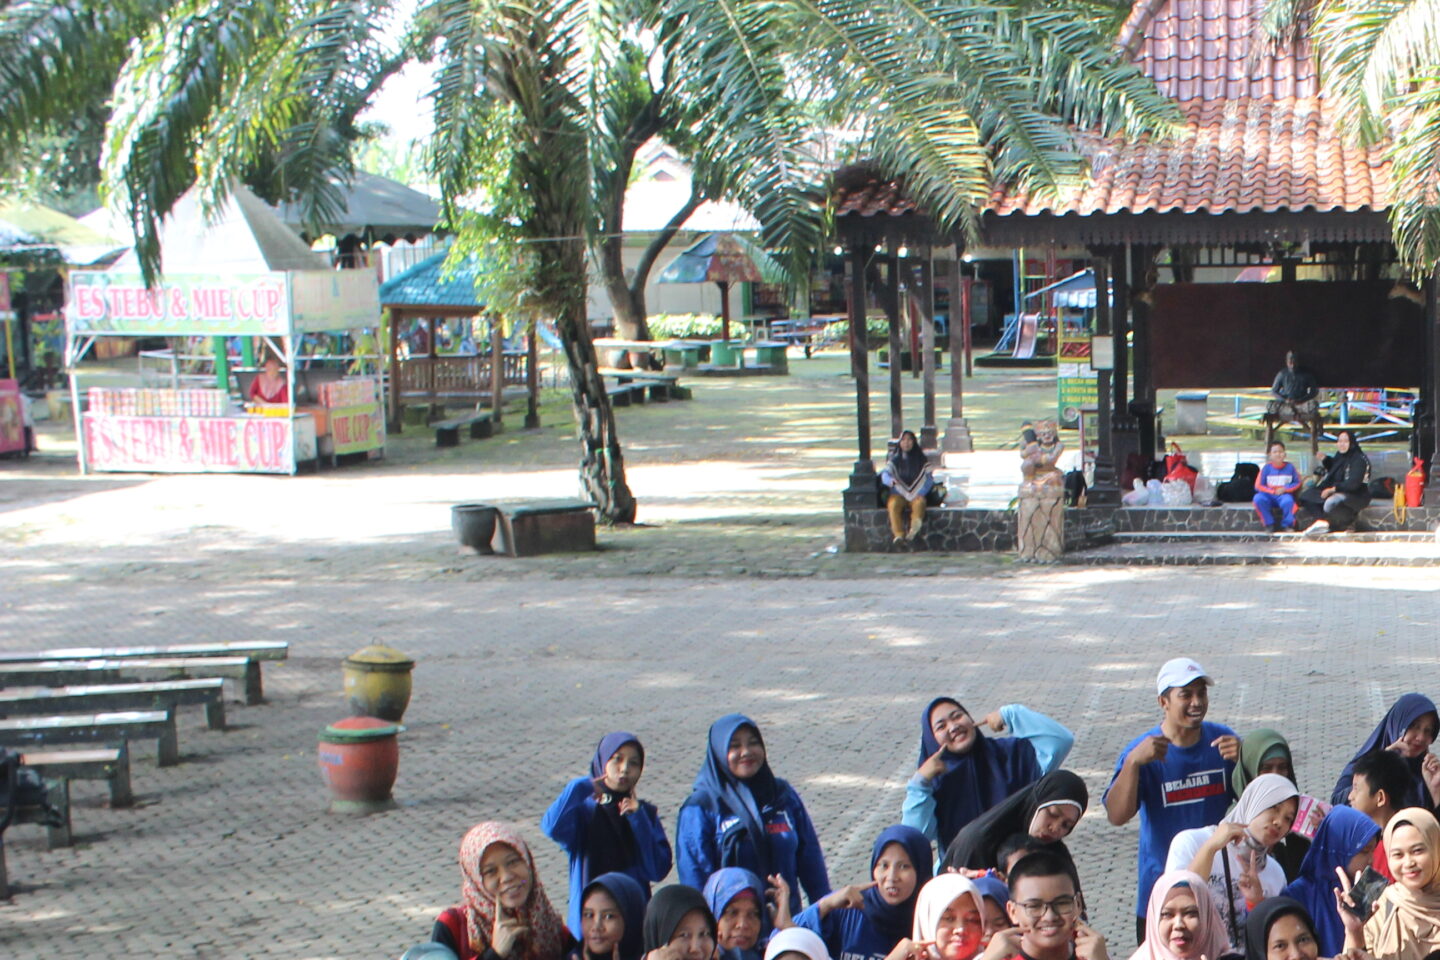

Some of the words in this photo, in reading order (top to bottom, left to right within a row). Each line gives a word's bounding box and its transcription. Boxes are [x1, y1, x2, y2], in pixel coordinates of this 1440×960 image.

[77, 288, 105, 318] ES
[108, 287, 163, 318] TEBU
[171, 288, 187, 318] &
[192, 288, 231, 318] MIE
[238, 288, 279, 318] CUP
[200, 419, 239, 467] MIE
[243, 419, 285, 469] CUP
[1164, 775, 1210, 792] BELAJAR
